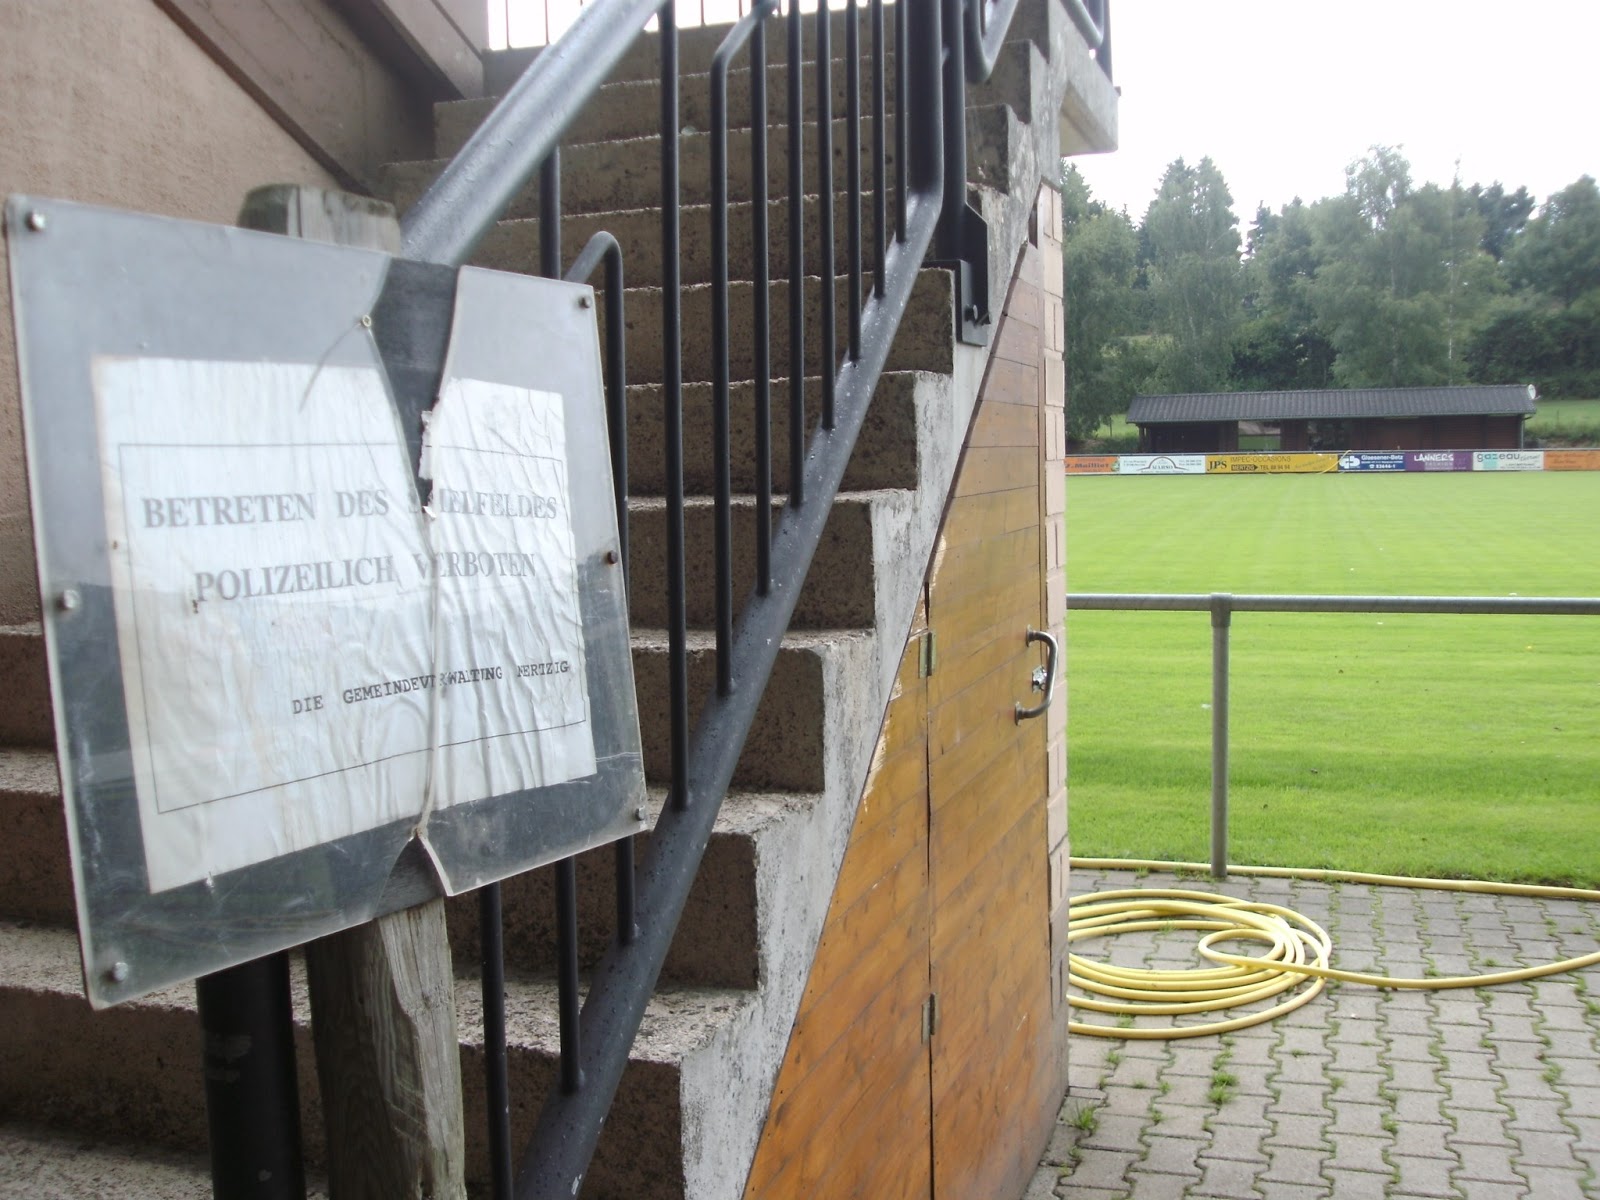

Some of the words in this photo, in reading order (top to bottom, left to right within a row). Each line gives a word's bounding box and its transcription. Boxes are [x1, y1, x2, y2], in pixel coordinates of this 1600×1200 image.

[1414, 453, 1454, 462] LANNERS
[1477, 453, 1520, 462] gazeau
[143, 492, 317, 528] BETRETEN
[336, 489, 390, 518] DES
[408, 488, 557, 519] SIELFELDES
[194, 554, 395, 602] POLIZEILICH
[292, 695, 324, 714] DIE
